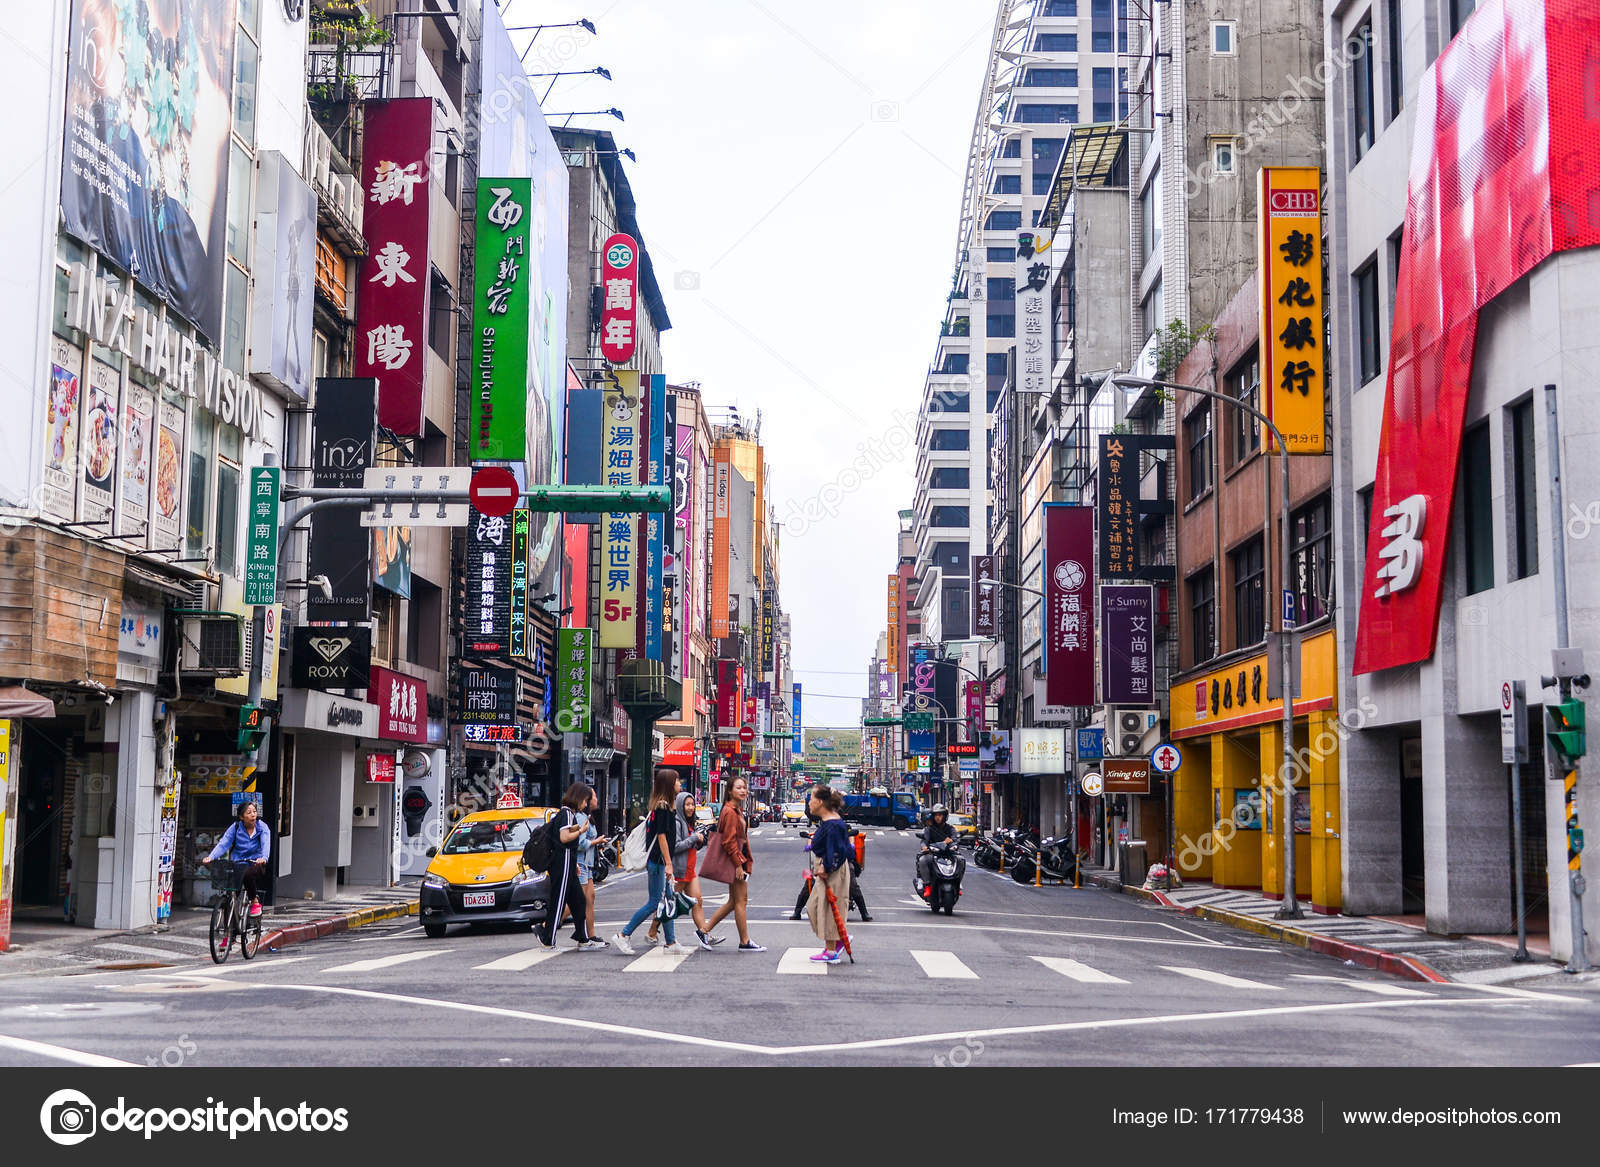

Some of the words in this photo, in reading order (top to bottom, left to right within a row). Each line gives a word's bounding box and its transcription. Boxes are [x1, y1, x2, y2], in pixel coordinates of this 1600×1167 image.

[1271, 191, 1317, 210] CHB
[365, 160, 422, 371] 新東陽
[486, 186, 523, 315] 西門新宿
[604, 278, 633, 349] 萬年
[1279, 229, 1316, 397] 彰化銀行
[135, 307, 196, 399] HAIR
[197, 345, 265, 442] VISION
[481, 327, 495, 401] Shinjuku
[480, 402, 493, 449] Plaza
[253, 480, 273, 560] 西寧南路
[248, 563, 275, 573] XiNing
[604, 599, 632, 622] 5F
[1060, 594, 1080, 651] 福勝亭
[1116, 597, 1148, 608] Sunny
[764, 617, 772, 660] HOTEL
[1130, 616, 1148, 694] 艾尚髮型
[308, 666, 349, 678] ROXY
[469, 671, 498, 688] Milla
[389, 678, 418, 722] 新東陽
[468, 690, 497, 710] 米勒
[1106, 771, 1131, 780] Xining
